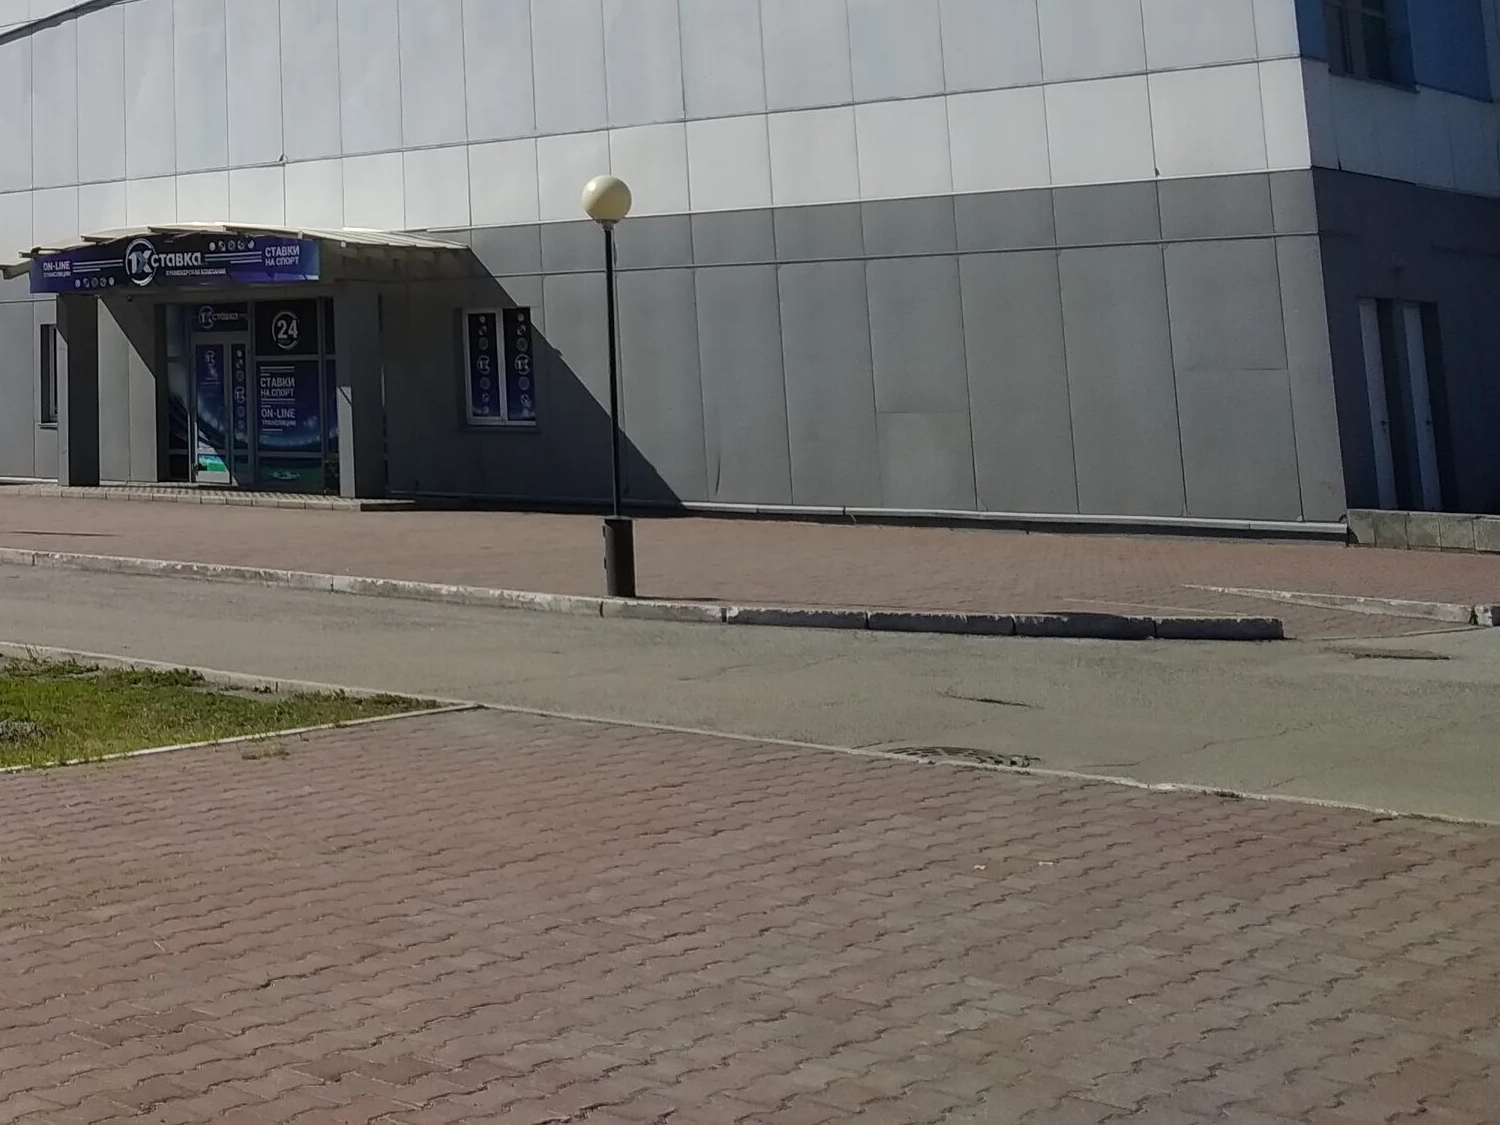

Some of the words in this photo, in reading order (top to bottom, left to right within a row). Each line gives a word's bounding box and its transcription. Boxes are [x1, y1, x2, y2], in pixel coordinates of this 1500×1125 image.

[265, 245, 299, 257] СТАВКИ
[276, 255, 299, 266] СПОРТ
[43, 261, 71, 271] ON-LINE
[277, 320, 298, 339] 24
[260, 377, 295, 387] СТАВКИ
[271, 388, 294, 397] СПОРТ
[261, 408, 296, 418] ON-LINE
